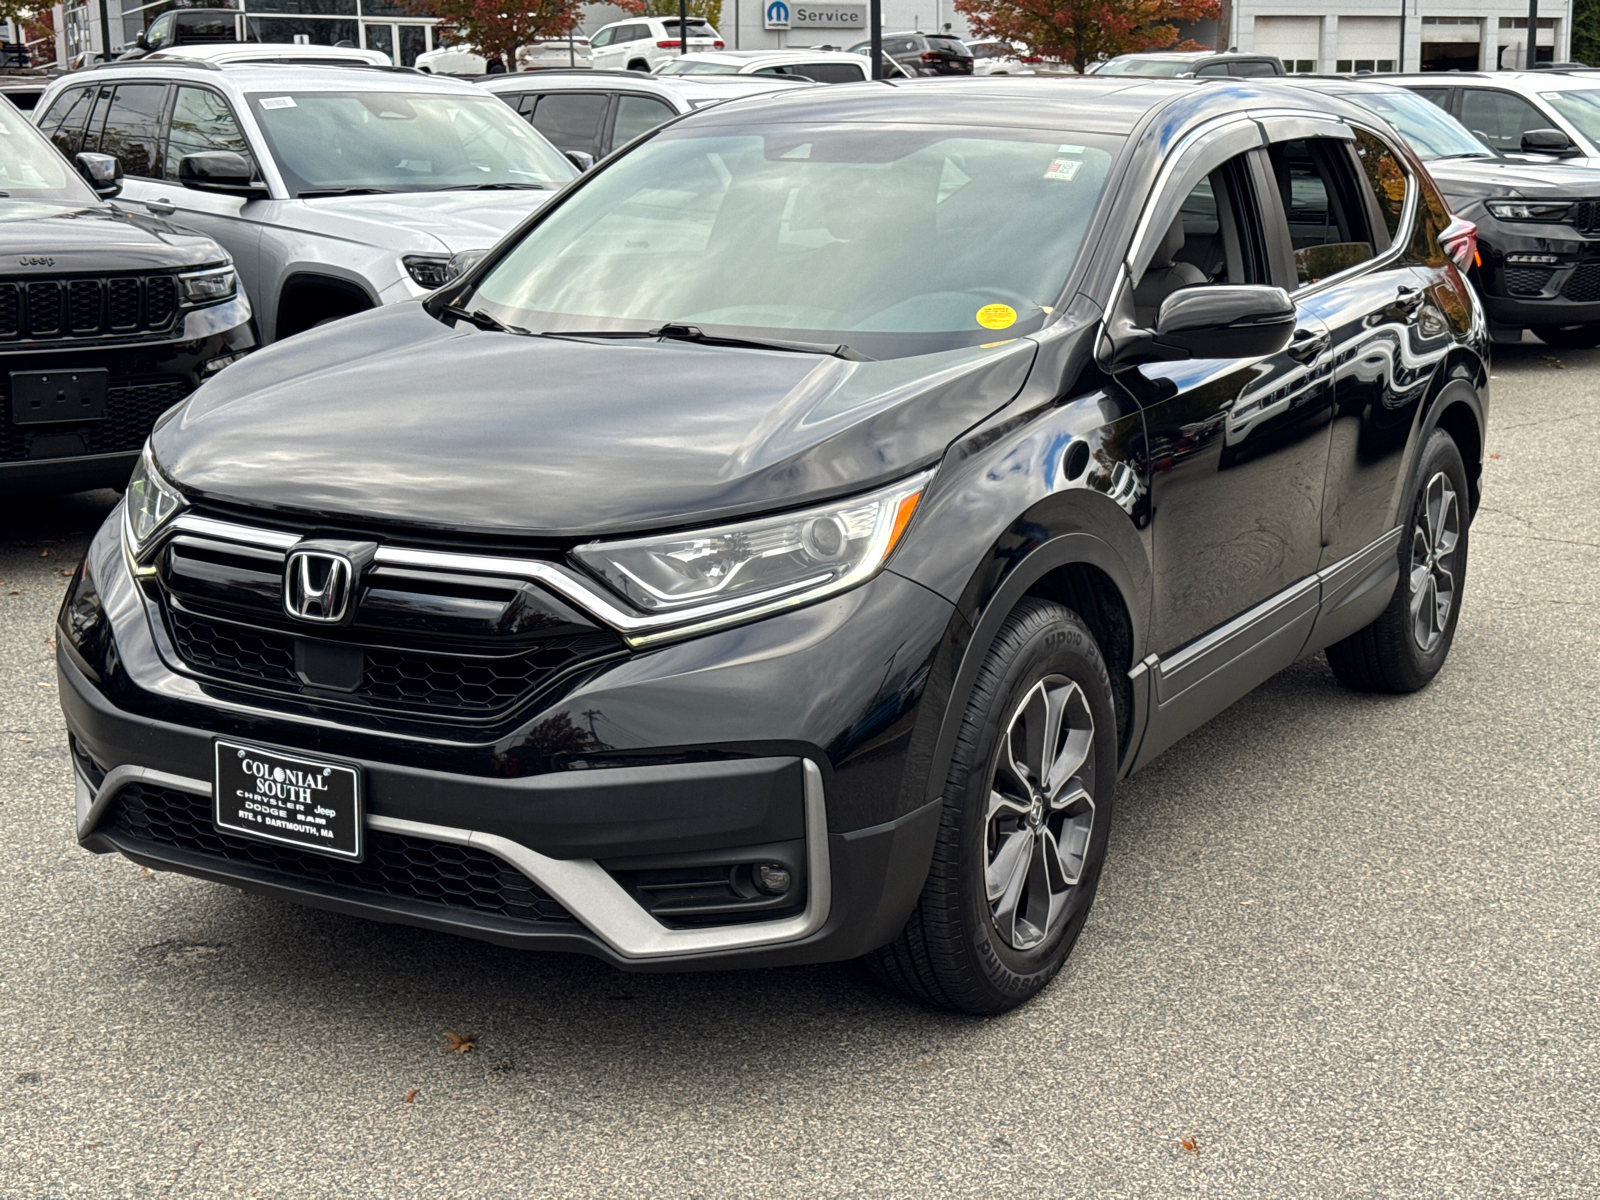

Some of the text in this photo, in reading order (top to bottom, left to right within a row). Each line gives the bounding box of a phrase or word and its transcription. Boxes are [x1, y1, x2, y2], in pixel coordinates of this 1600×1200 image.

[797, 9, 859, 22] Service
[19, 256, 55, 267] Jeep
[242, 758, 328, 791] COLONIAL
[236, 790, 305, 811] CHRYSLER
[256, 778, 312, 804] SOUTH
[245, 801, 326, 825] DODGE RAM
[314, 805, 336, 818] Jeep
[238, 810, 334, 838] RTE. 6 DARTMOUTH, MA
